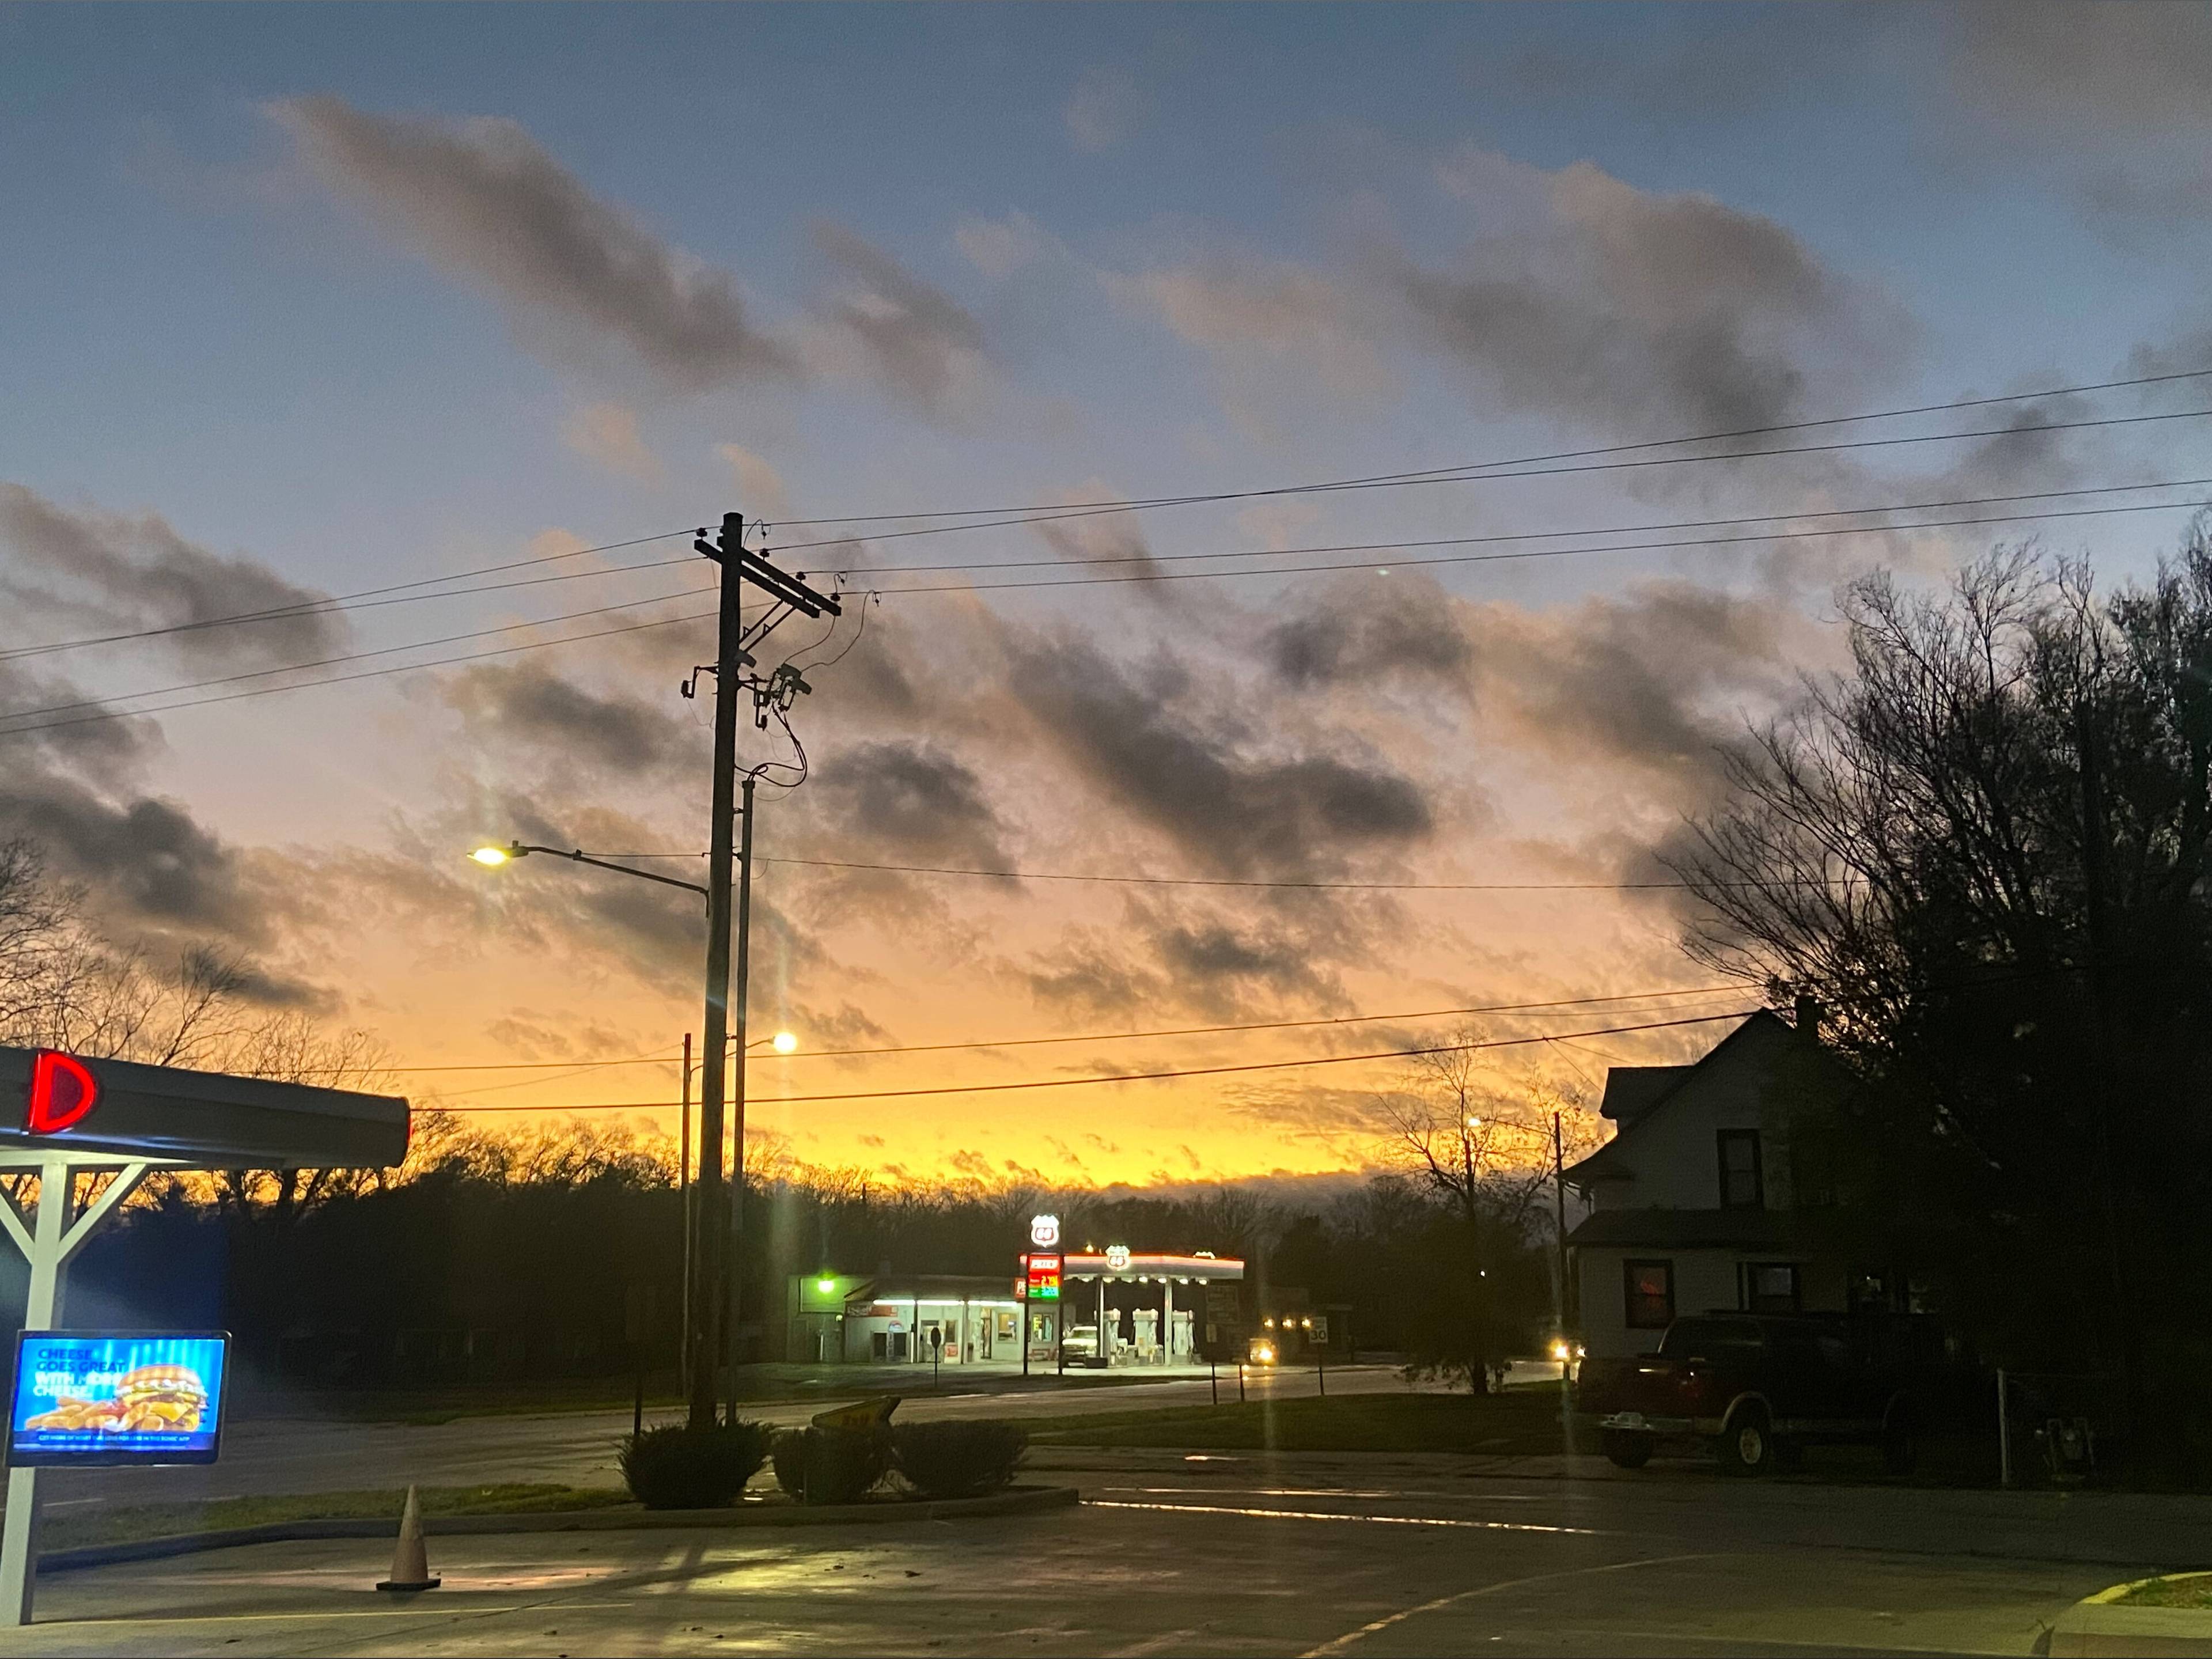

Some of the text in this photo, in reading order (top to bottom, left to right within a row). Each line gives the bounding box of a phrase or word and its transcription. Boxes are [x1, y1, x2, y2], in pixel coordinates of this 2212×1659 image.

[1036, 1228, 1052, 1240] 66
[1110, 1256, 1124, 1266] 66
[1310, 1330, 1326, 1340] 30
[38, 1349, 92, 1359] CHEESE
[37, 1361, 126, 1372] GOES GREAT
[35, 1371, 74, 1385] WITH
